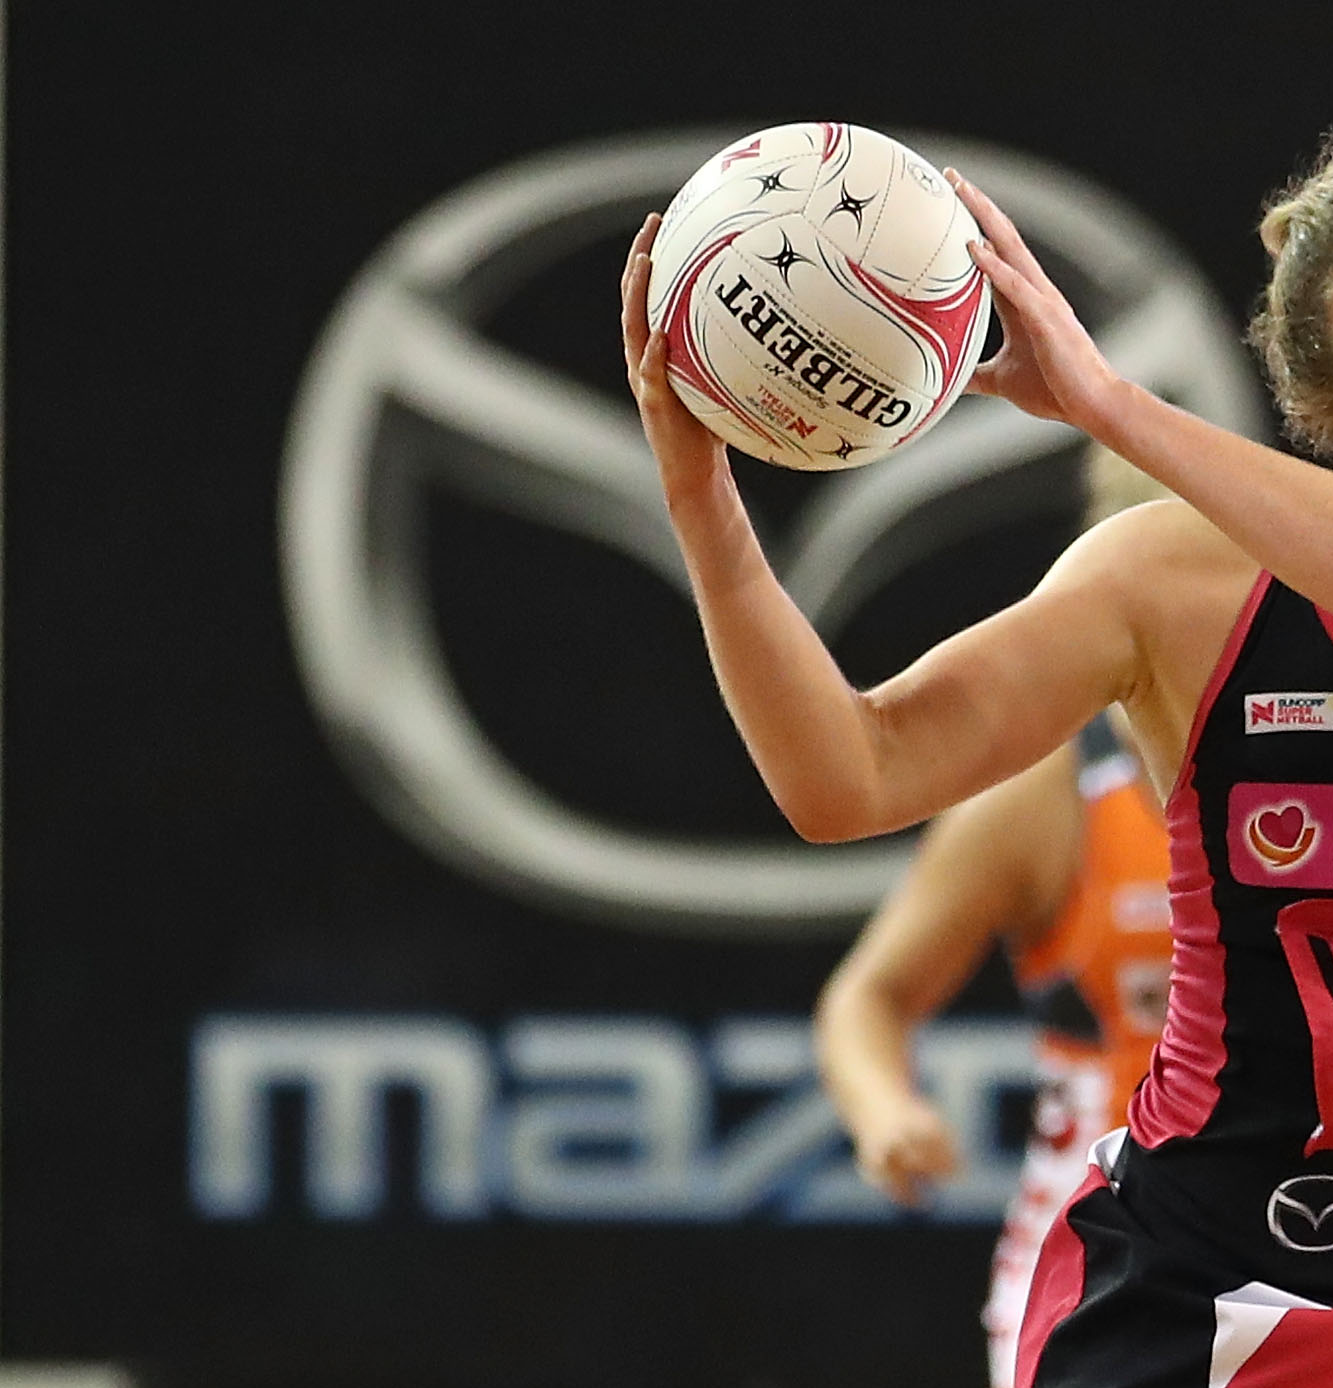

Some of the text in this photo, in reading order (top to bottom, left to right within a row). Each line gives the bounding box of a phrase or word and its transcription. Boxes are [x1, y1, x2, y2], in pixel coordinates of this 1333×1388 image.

[714, 273, 912, 429] GILBERT
[1277, 706, 1313, 716] SUPER
[1277, 715, 1325, 724] NETBALL
